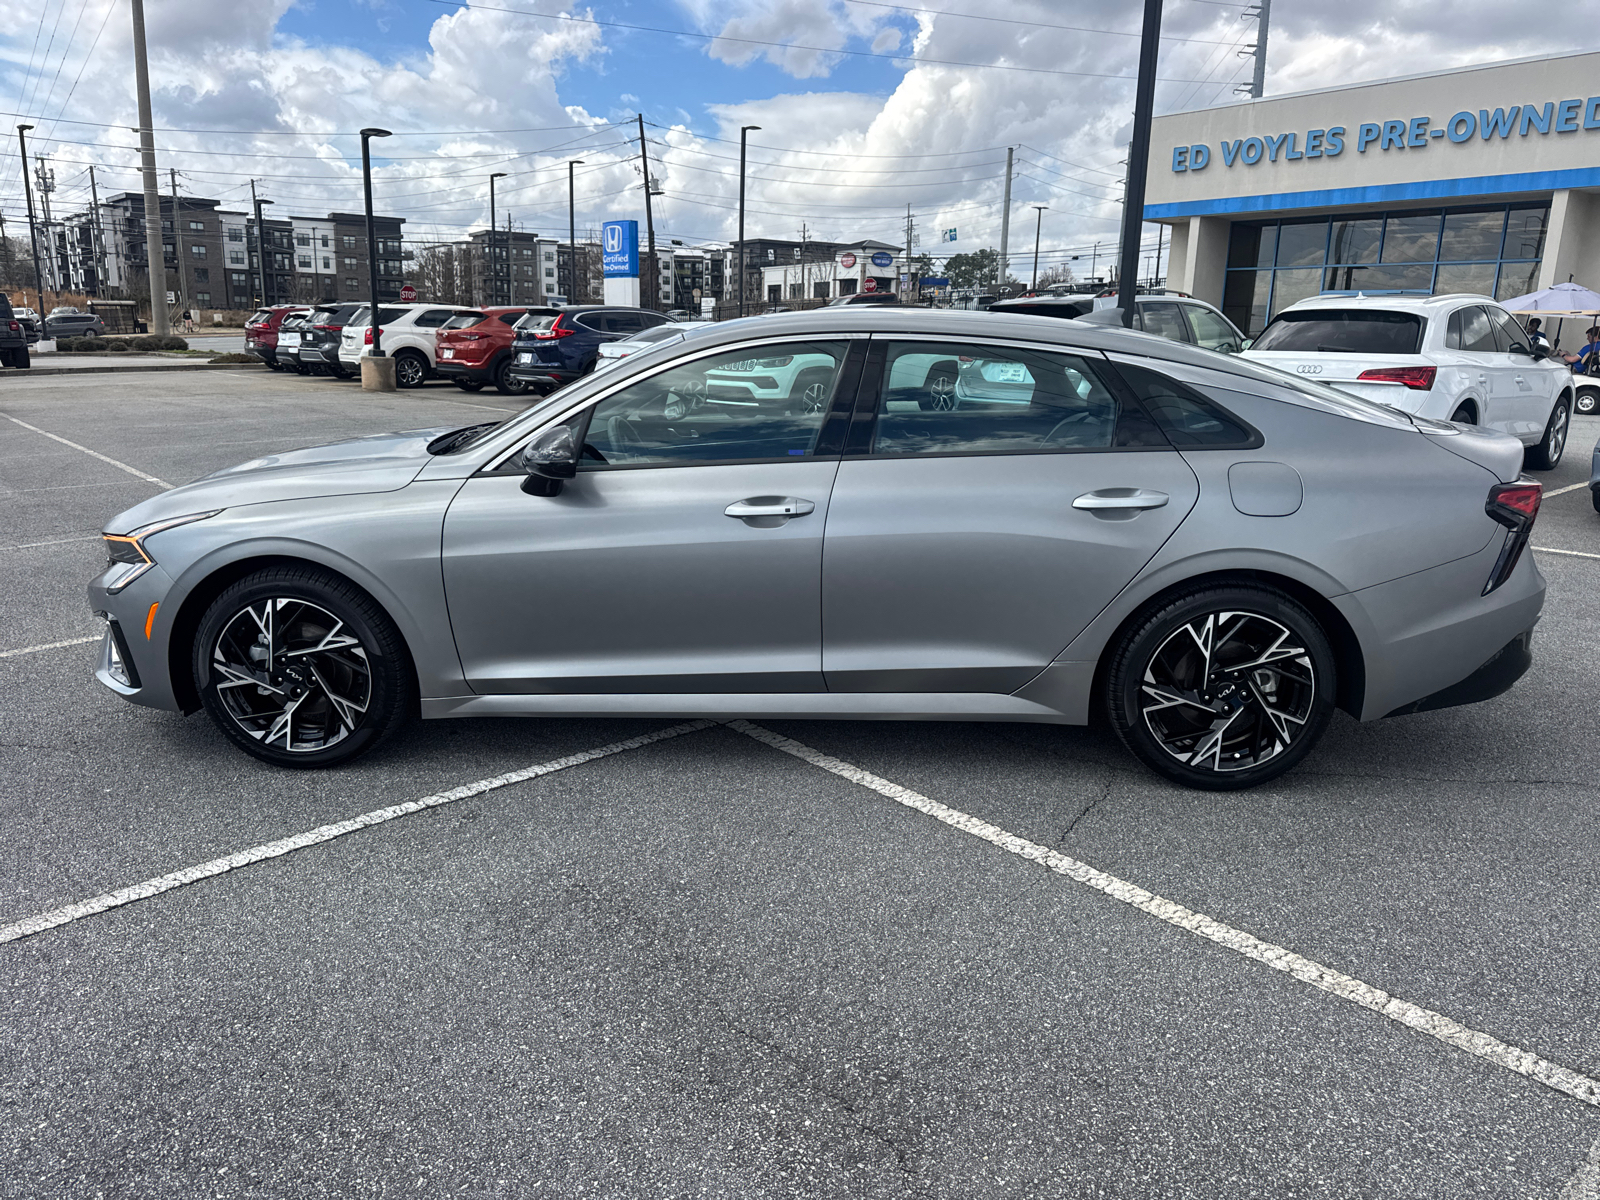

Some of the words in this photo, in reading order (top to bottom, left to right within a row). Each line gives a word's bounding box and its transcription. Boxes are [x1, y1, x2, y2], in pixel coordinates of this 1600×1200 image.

[1171, 144, 1210, 172] ED
[1220, 126, 1346, 167] VOYLES
[1357, 96, 1600, 153] PRE-OWNED
[603, 254, 629, 263] Certified
[603, 263, 629, 271] Pre-Owned
[401, 291, 417, 299] STOP
